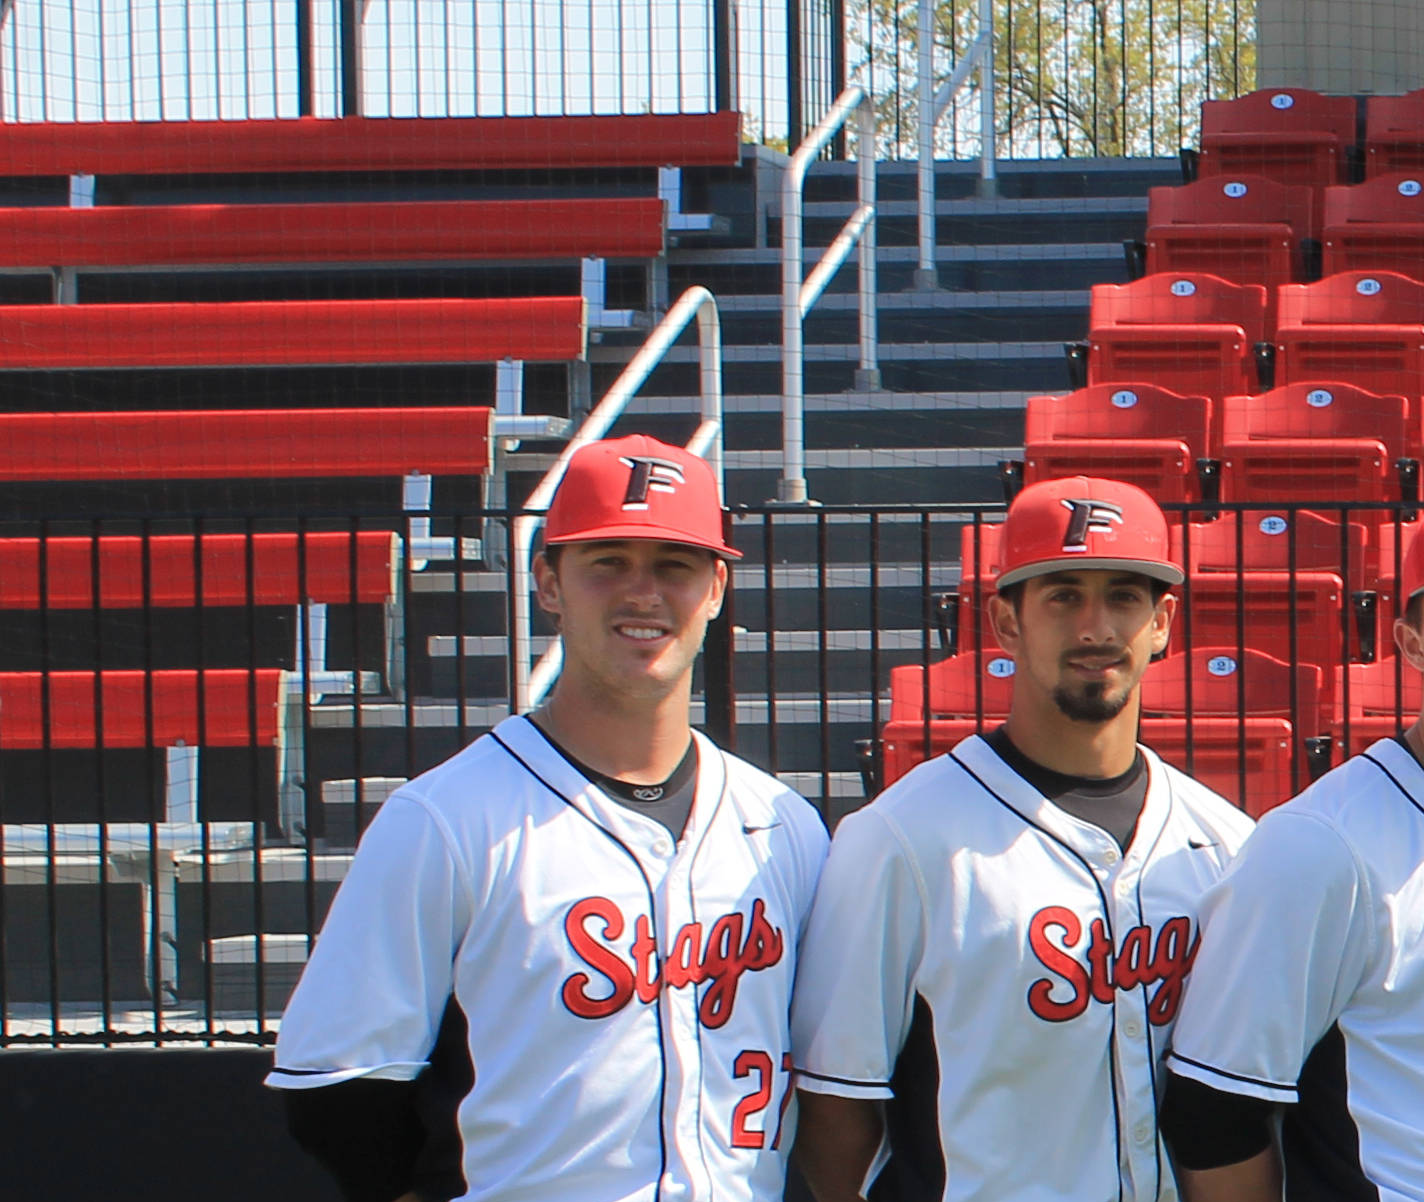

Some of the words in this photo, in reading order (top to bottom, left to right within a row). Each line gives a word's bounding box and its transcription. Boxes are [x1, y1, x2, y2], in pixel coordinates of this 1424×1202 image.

[618, 455, 685, 511] F
[1061, 499, 1124, 552] F
[562, 895, 784, 1030] Stags
[1028, 906, 1202, 1026] Stag
